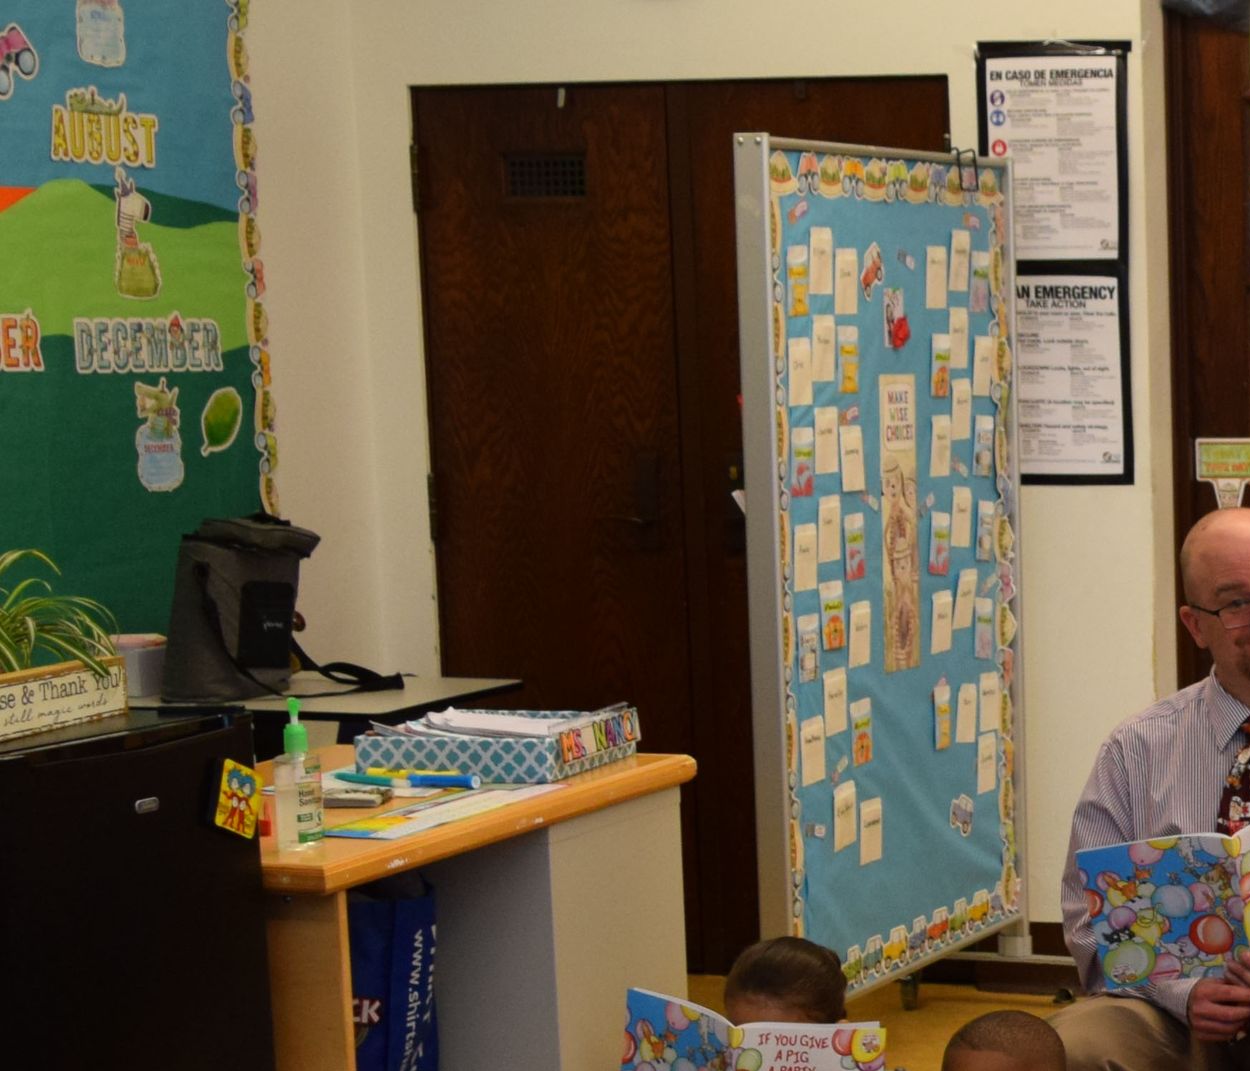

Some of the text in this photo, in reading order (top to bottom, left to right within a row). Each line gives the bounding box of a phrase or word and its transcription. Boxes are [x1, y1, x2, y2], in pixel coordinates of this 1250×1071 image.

[989, 68, 1114, 81] EN CASO DE EMERGENCIA
[52, 106, 157, 166] AUGUST
[1034, 285, 1116, 300] EMERGENCY
[1025, 300, 1087, 309] TAKE ACTION
[75, 318, 222, 369] DECEMBER
[38, 675, 89, 701] Thank
[3, 692, 107, 727] still magic words
[757, 1032, 829, 1050] IF YOU GIVE
[774, 1048, 810, 1064] A PIG
